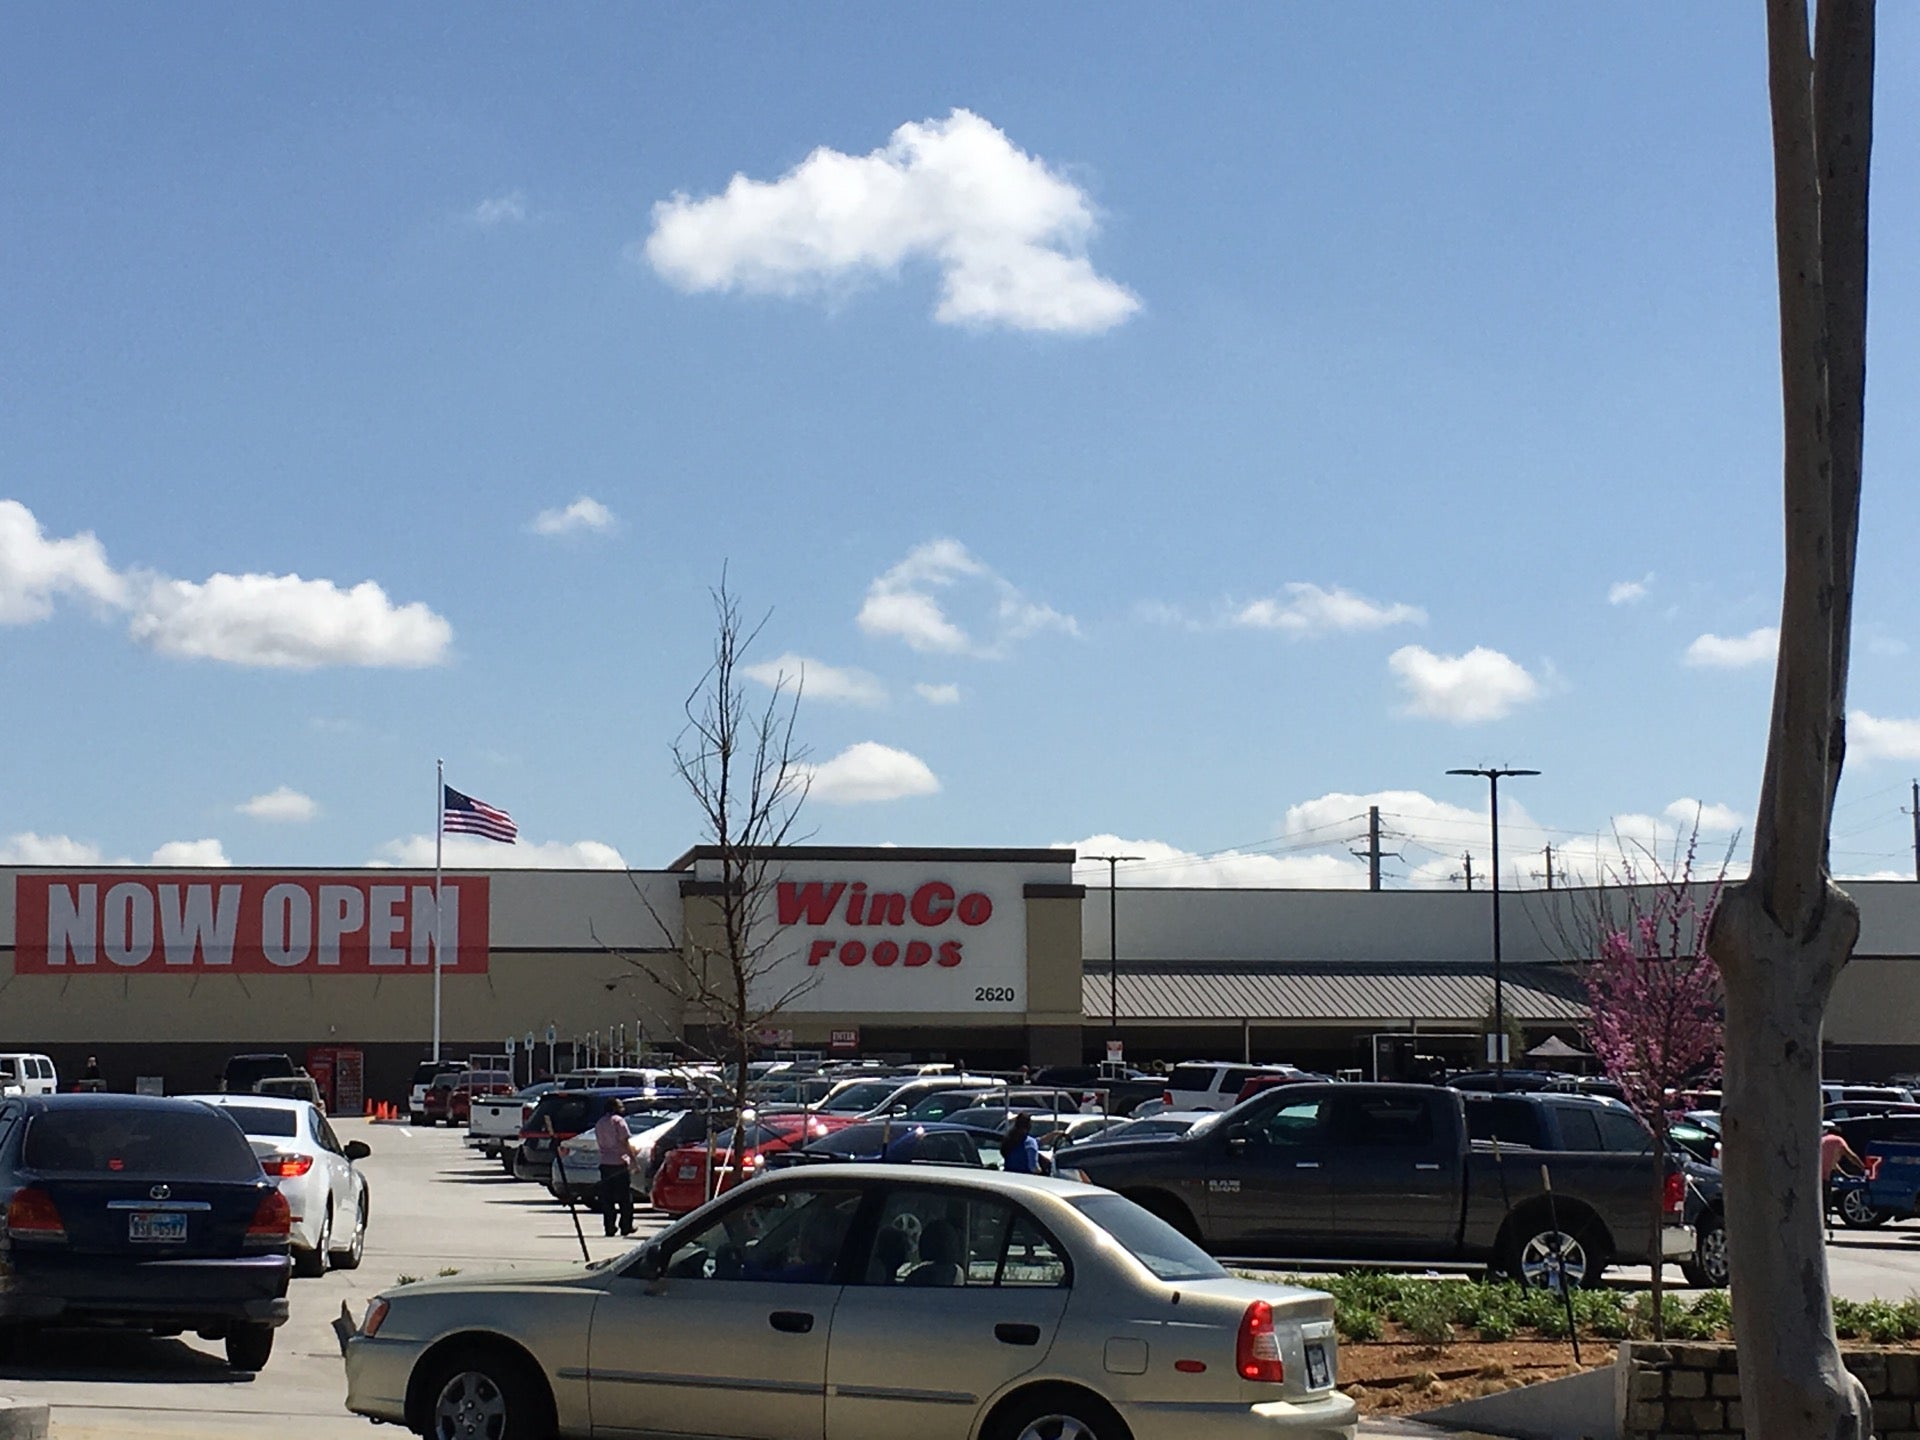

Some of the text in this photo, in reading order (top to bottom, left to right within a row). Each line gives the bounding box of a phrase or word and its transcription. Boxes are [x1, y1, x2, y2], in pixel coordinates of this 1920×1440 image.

[776, 880, 993, 927] WinCo
[46, 882, 460, 967] NOW OPEN
[807, 940, 964, 968] FOODS
[975, 987, 1015, 1003] 2620
